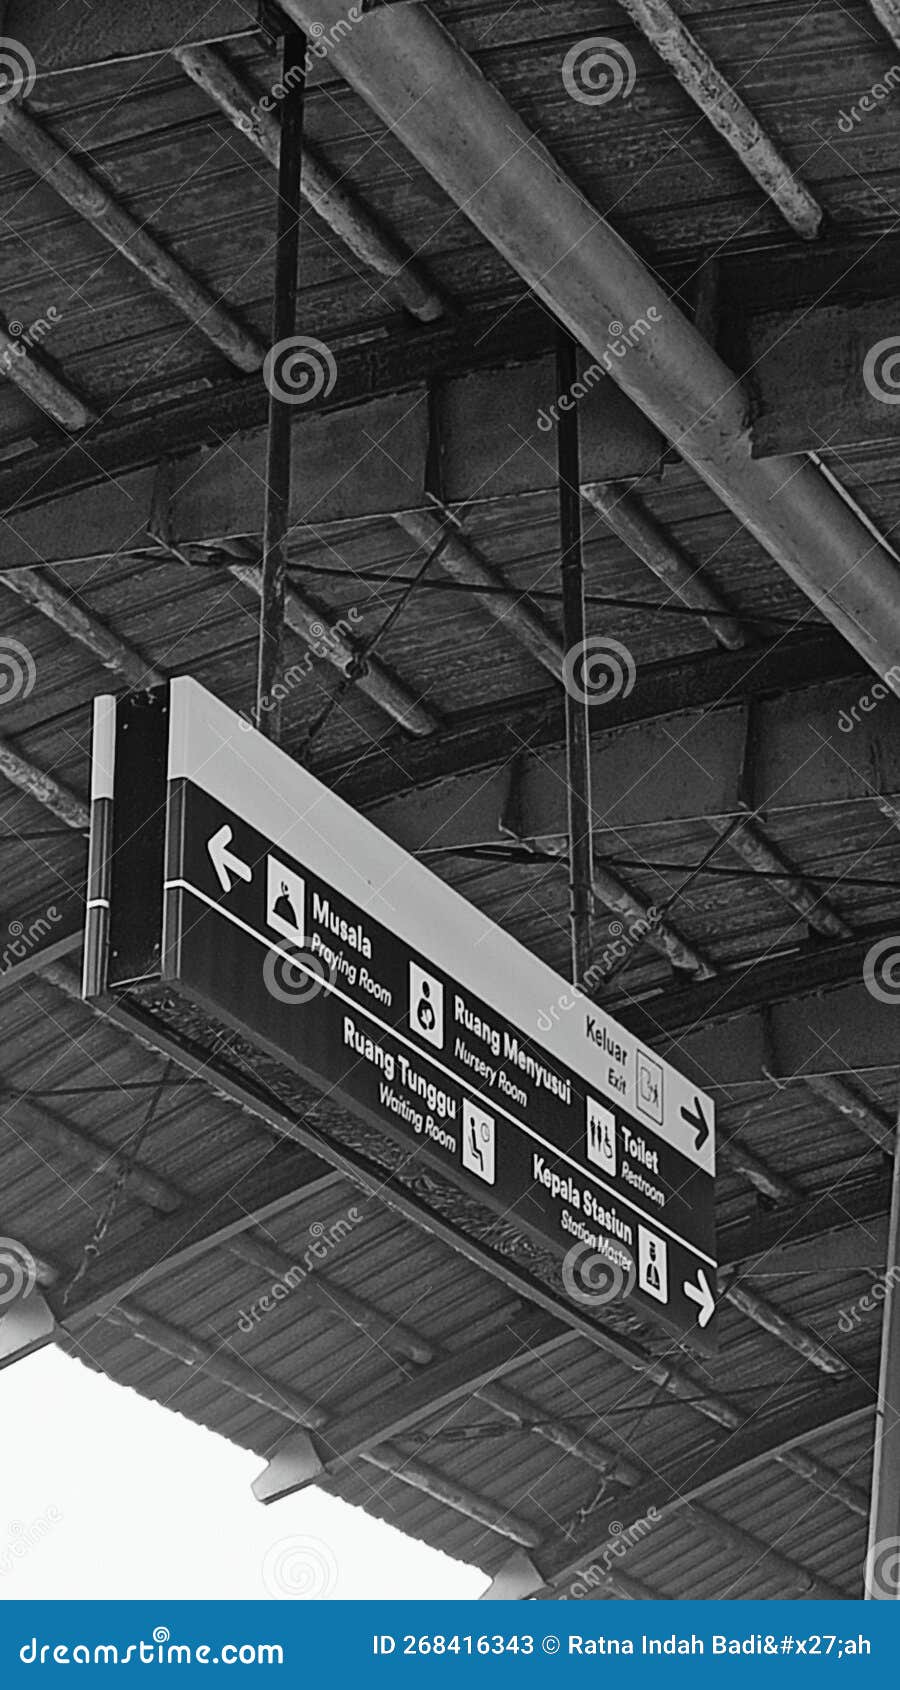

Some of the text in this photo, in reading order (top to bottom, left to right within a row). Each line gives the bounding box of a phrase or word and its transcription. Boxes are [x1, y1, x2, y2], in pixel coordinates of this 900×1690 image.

[313, 892, 372, 960] Musala
[311, 933, 393, 1008] Praying Room
[343, 1016, 457, 1120] Ruang Tunggu
[454, 994, 572, 1105] Ruang Menyusui
[454, 1037, 528, 1108] Nursery Room
[586, 1014, 628, 1067] Keluar
[608, 1067, 627, 1096] Exit
[379, 1082, 457, 1153] Waiting Room
[621, 1125, 660, 1175] Toilet
[533, 1153, 633, 1246] Kepala Stasiun
[621, 1160, 666, 1208] Restroom
[560, 1208, 633, 1273] Station Master
